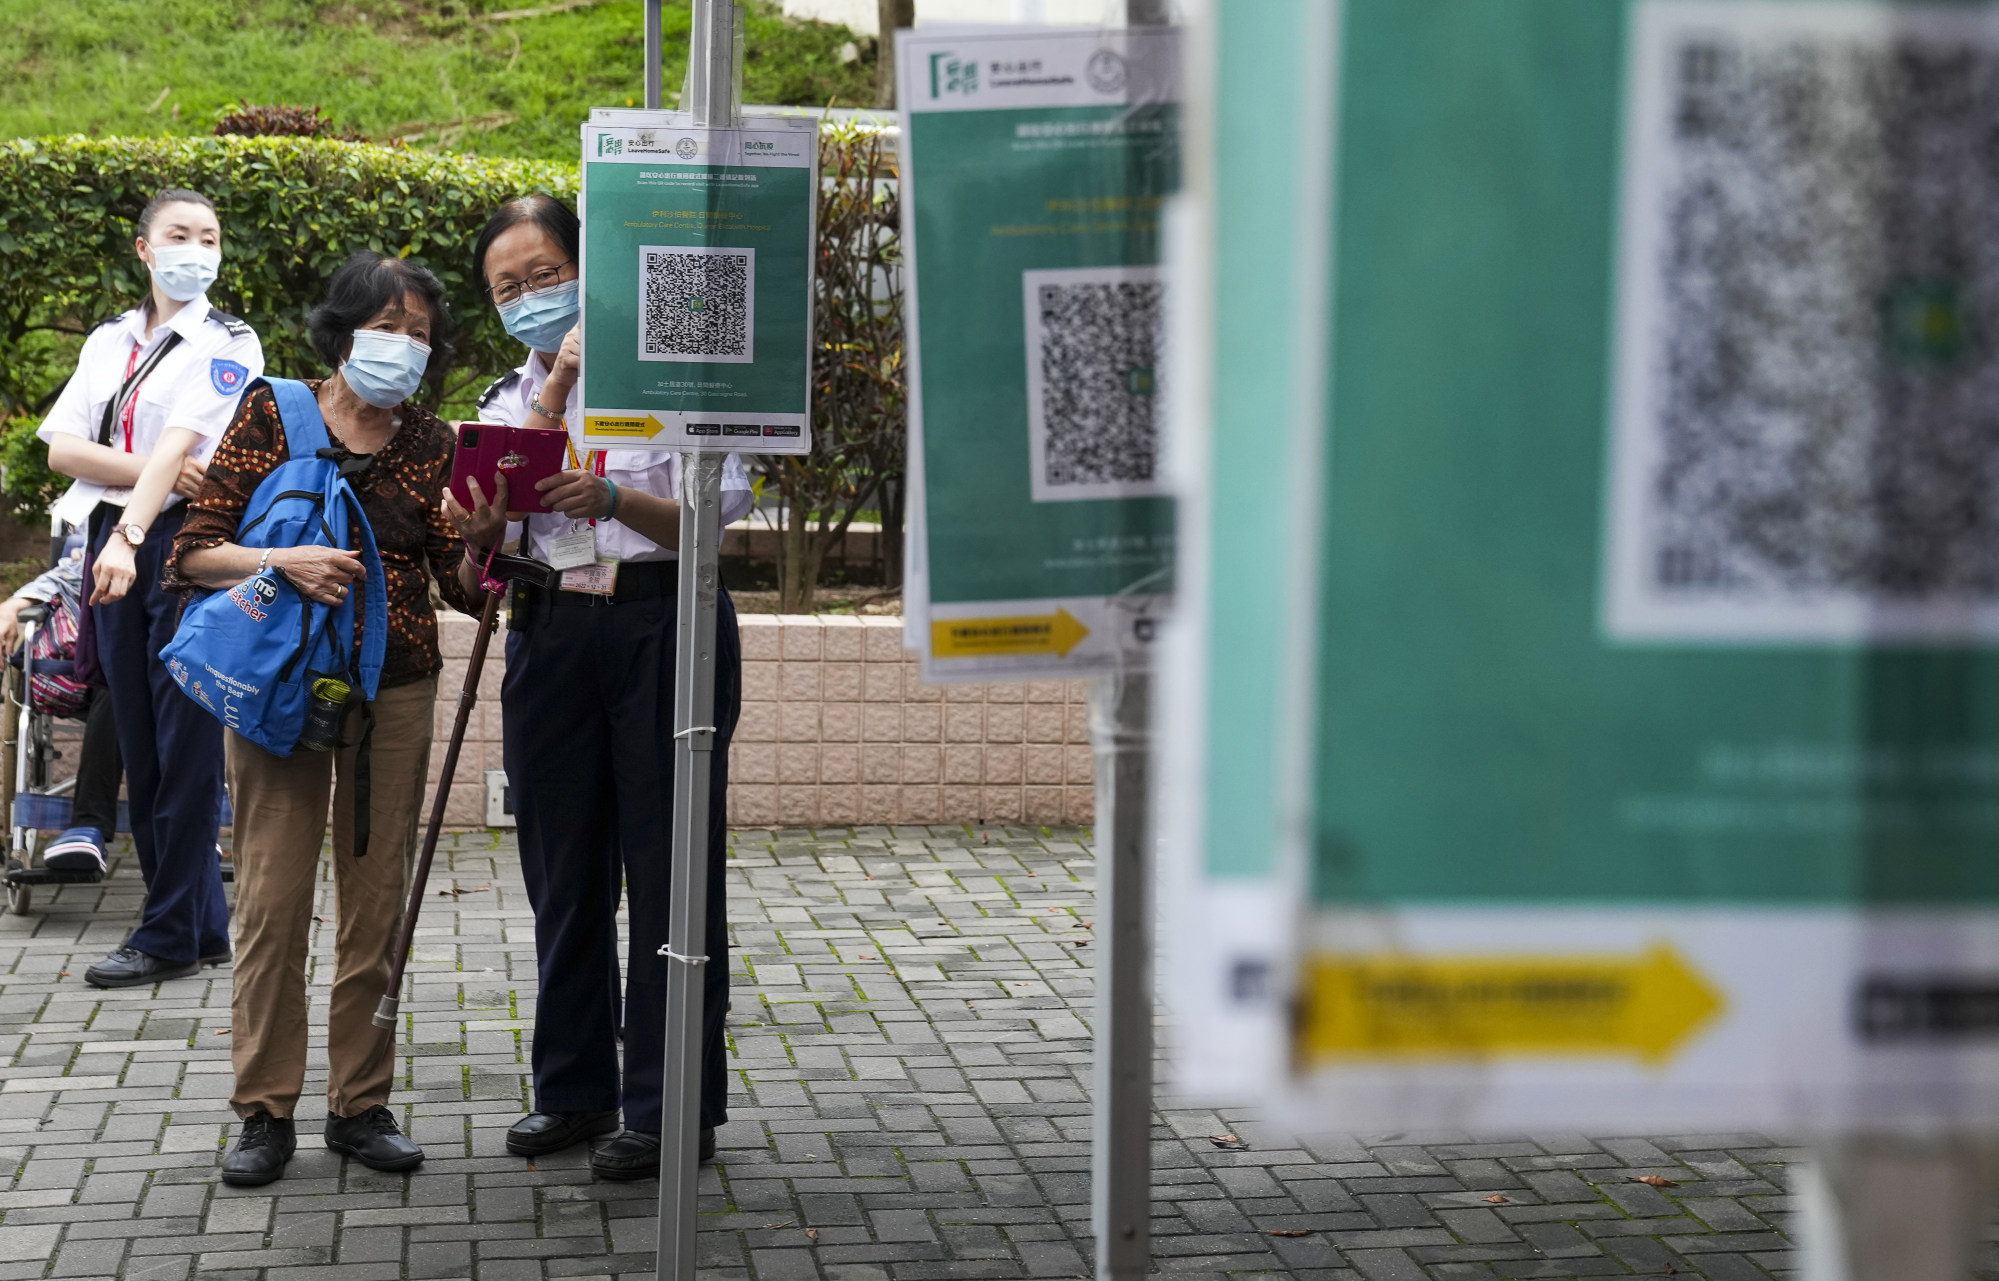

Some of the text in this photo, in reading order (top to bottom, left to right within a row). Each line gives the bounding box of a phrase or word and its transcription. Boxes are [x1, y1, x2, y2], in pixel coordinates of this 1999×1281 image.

[744, 142, 774, 150] 同心抗疫
[624, 221, 657, 229] Ambulatory
[642, 389, 669, 397] Ambulatory
[254, 579, 277, 598] ms
[205, 662, 260, 696] Unquestionably
[215, 679, 244, 699] the Best
